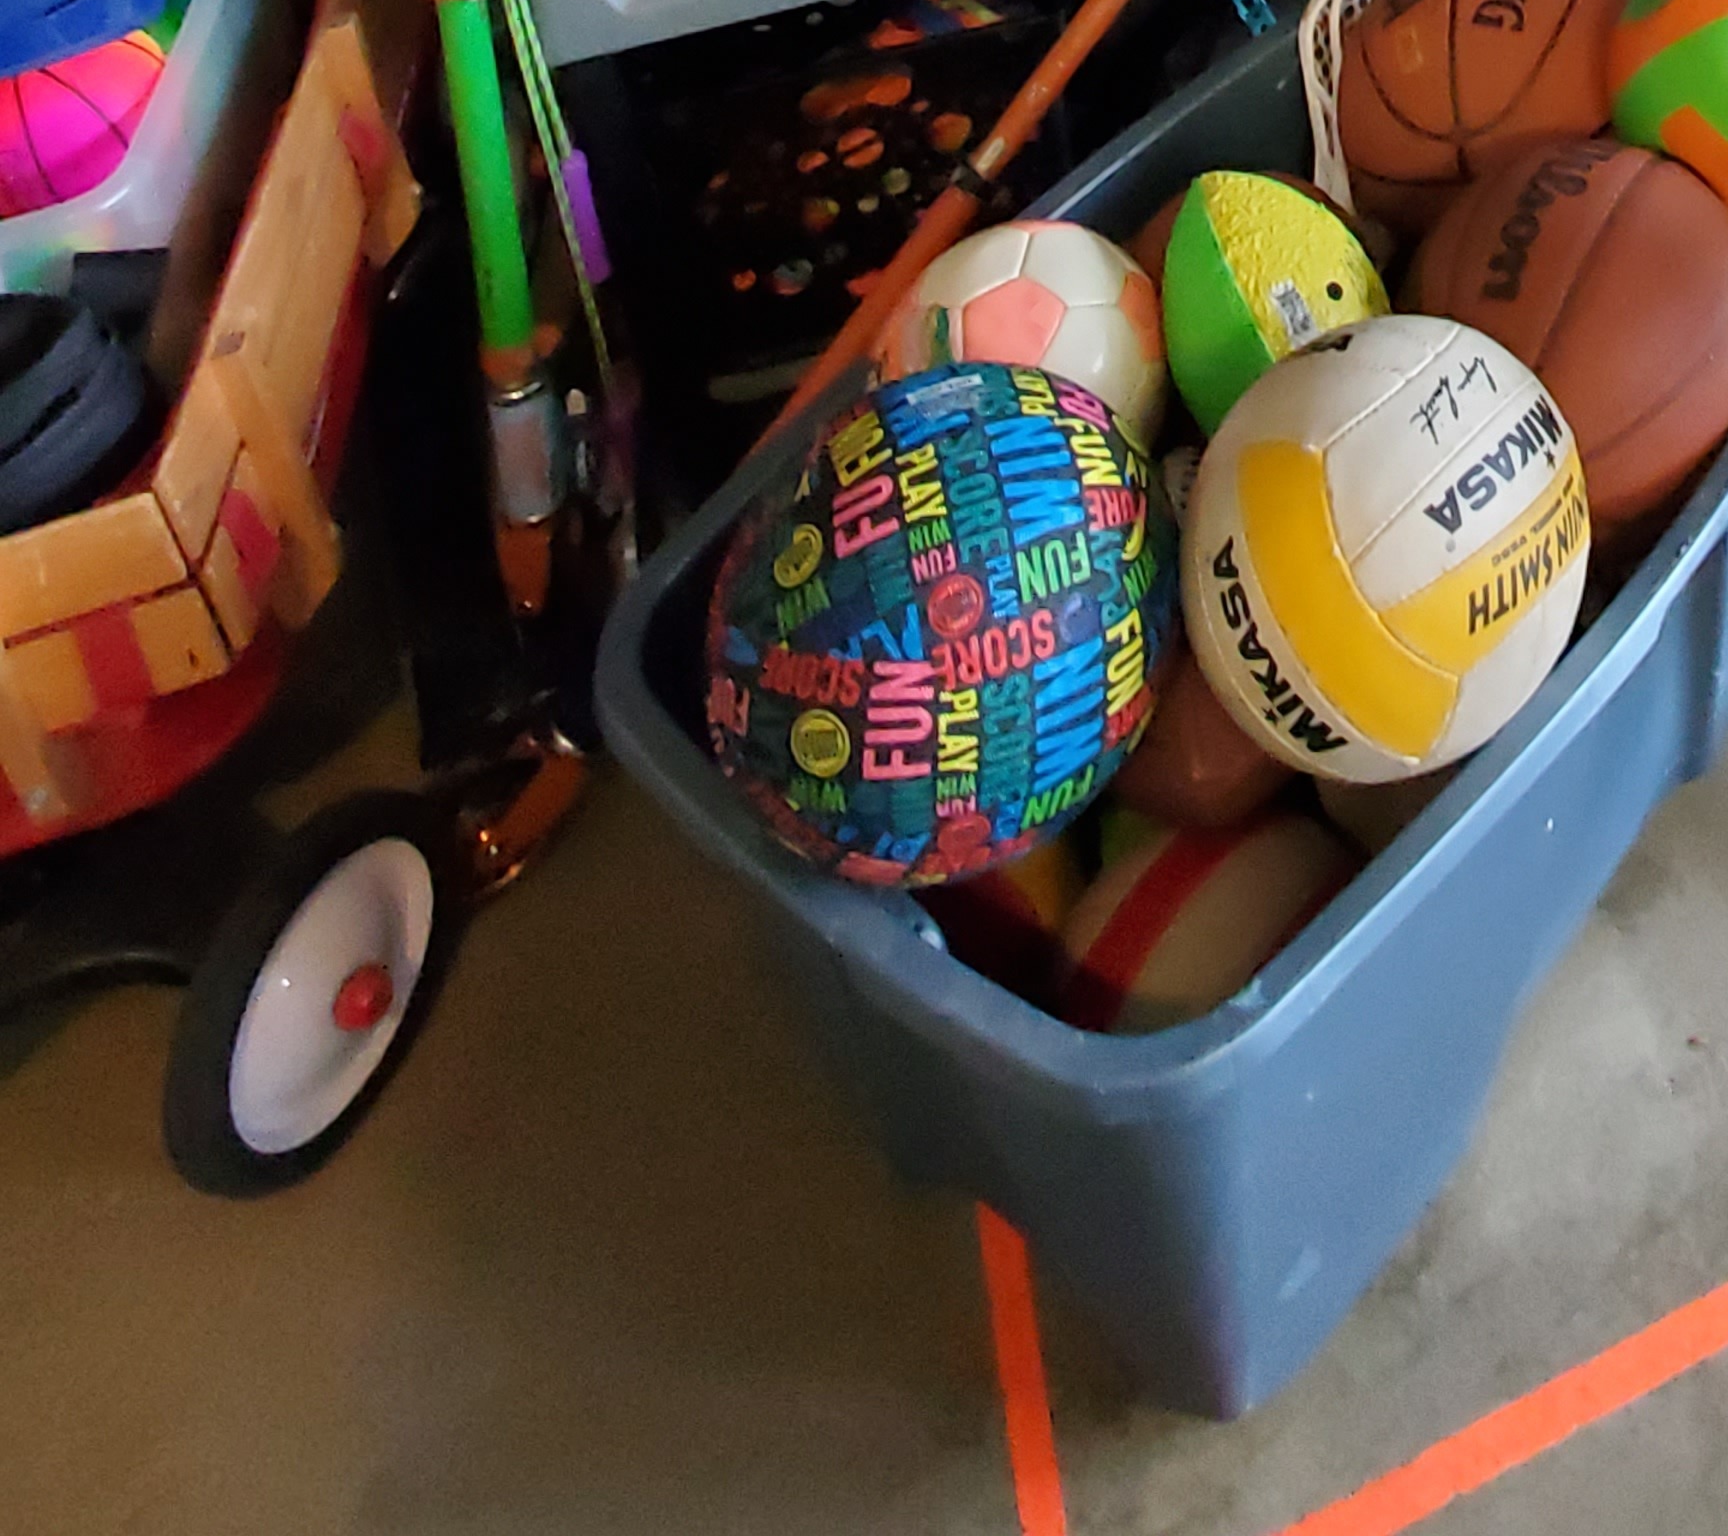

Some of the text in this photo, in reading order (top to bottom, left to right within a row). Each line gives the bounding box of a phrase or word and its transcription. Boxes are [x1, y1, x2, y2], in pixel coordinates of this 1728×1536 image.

[895, 442, 948, 523] PLAY
[983, 415, 1086, 547] WIN
[908, 517, 952, 553] WIN
[911, 542, 957, 585] FUN
[1016, 530, 1092, 604] FUN
[1468, 531, 1555, 636] SMITH
[931, 608, 1056, 690] SCORE
[1105, 608, 1143, 716] FUN
[862, 659, 936, 780] FUN
[937, 688, 979, 773] PLAY
[1032, 636, 1104, 795] WIN
[1021, 763, 1094, 829] FUN
